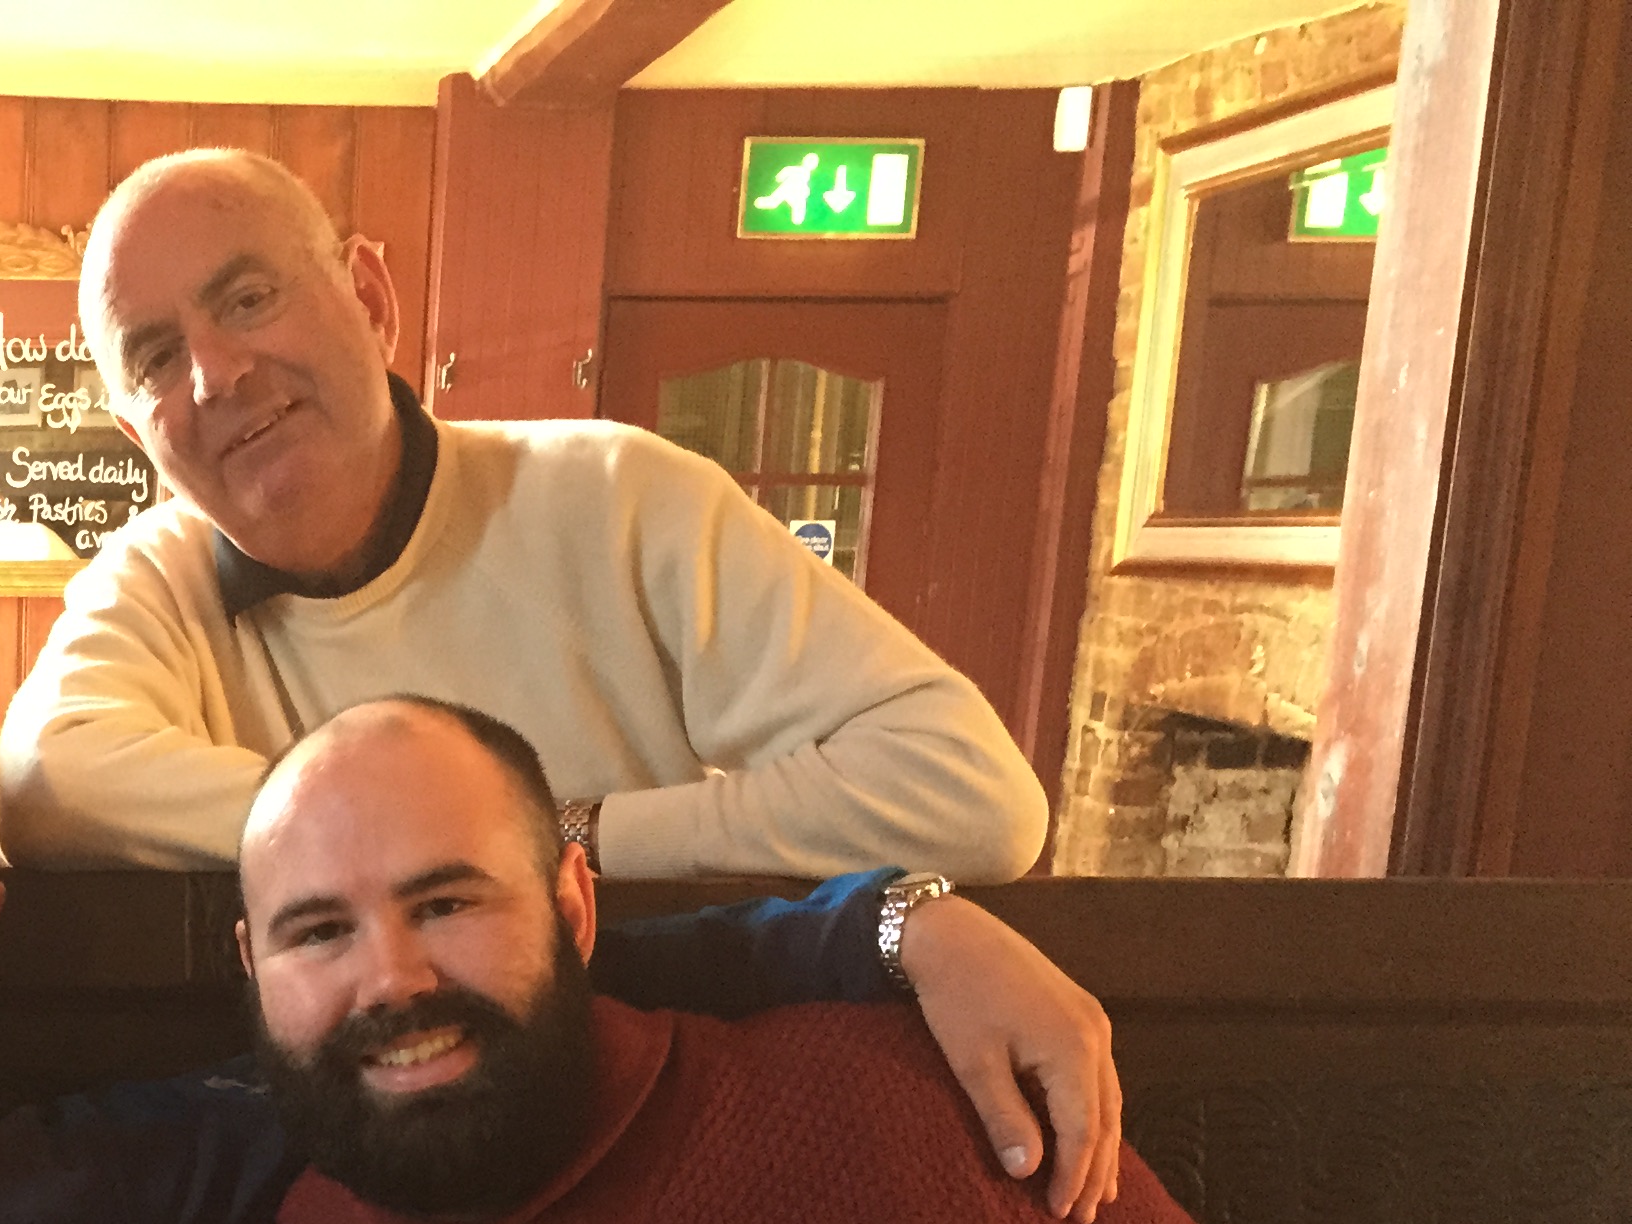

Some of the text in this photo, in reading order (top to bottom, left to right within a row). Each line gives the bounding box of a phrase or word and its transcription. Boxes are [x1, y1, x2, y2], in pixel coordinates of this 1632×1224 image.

[38, 383, 92, 435] Eggs
[5, 446, 148, 503] Served daily
[28, 493, 108, 526] Pastries
